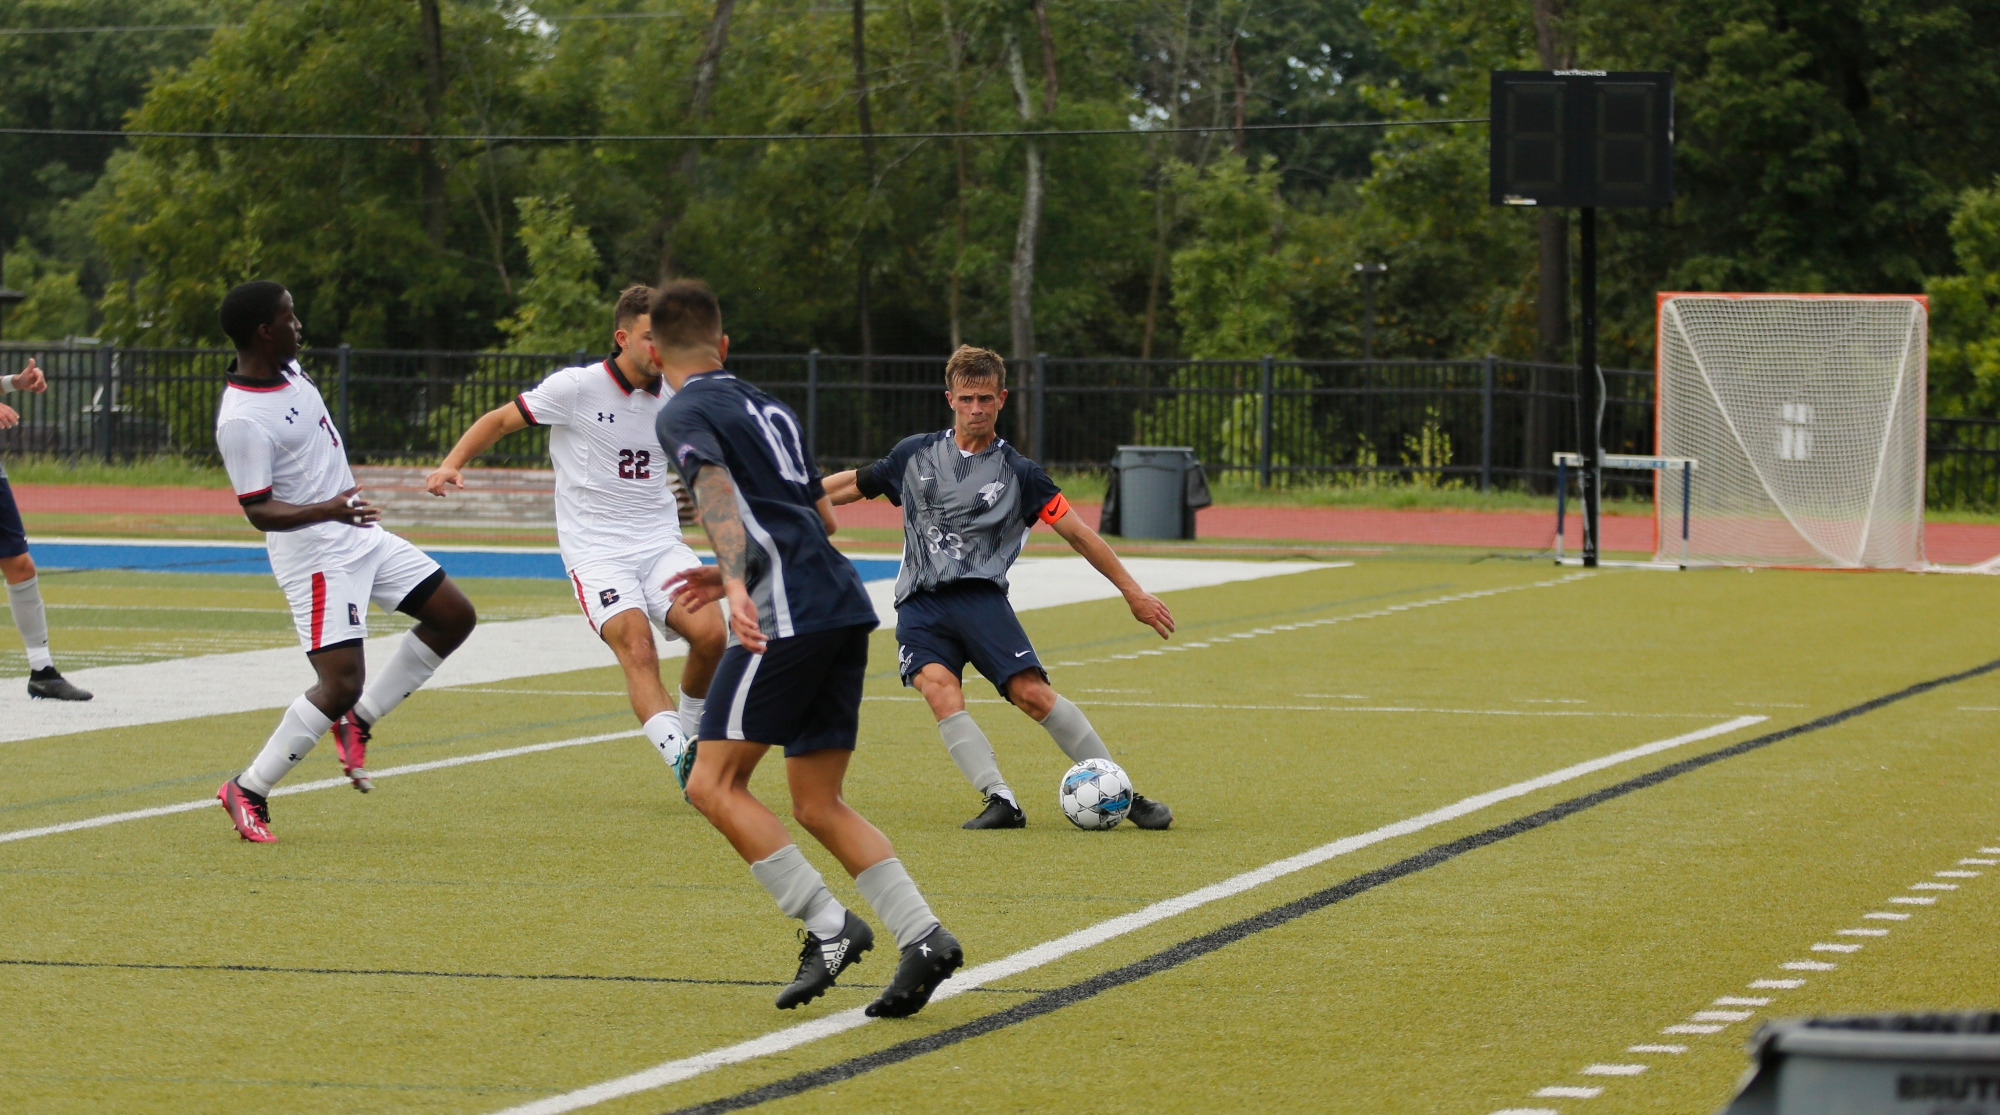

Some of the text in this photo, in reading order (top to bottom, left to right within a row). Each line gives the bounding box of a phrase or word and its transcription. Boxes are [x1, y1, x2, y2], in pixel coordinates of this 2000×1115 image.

[746, 399, 809, 486] 10
[618, 448, 650, 480] 22
[927, 525, 964, 561] 33
[829, 938, 851, 976] adidas
[1897, 1075, 2000, 1101] BRUT
